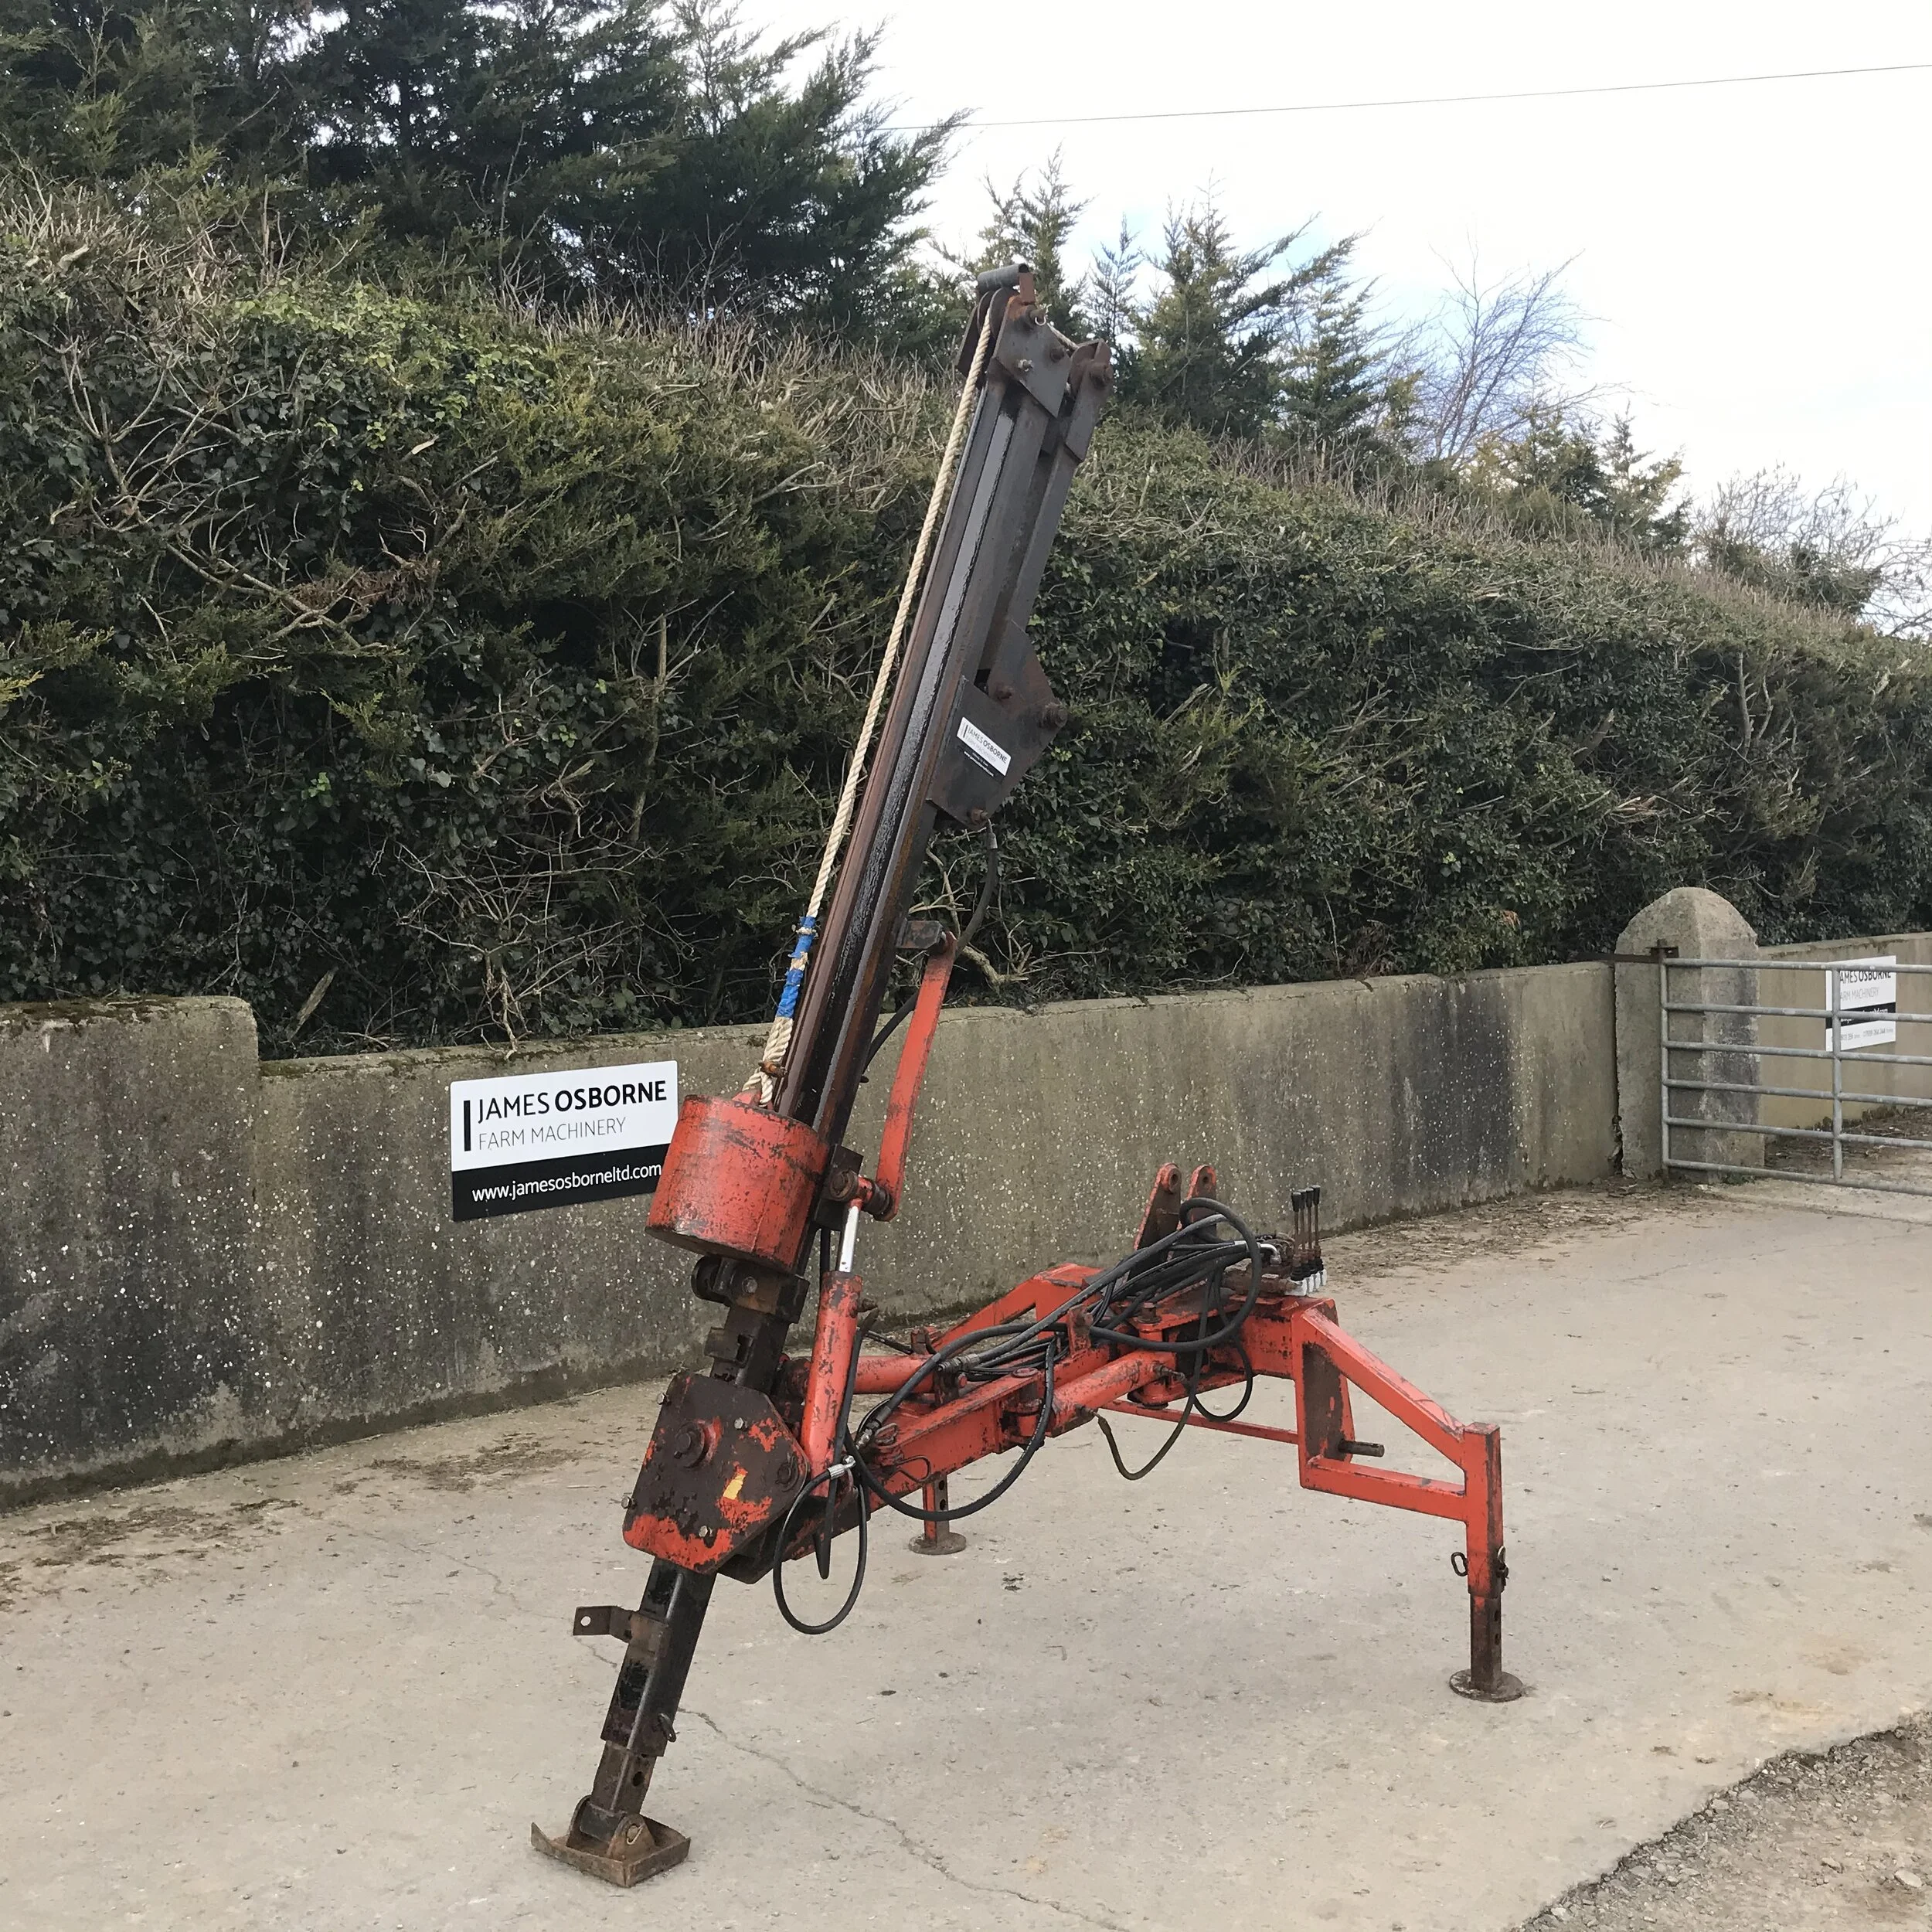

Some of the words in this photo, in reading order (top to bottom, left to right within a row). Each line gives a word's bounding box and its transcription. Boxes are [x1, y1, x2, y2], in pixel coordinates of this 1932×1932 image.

[968, 726, 983, 743] JAMES
[982, 740, 1008, 764] OSBORNE
[1840, 970, 1858, 984] AMES
[1840, 990, 1851, 1002] ARM
[478, 1092, 549, 1124] JAMES
[554, 1080, 667, 1112] OSBORNE
[479, 1129, 525, 1150] FARM
[531, 1117, 626, 1144] MACHINERY
[472, 1163, 662, 1202] www.jamesosborneltd.com
